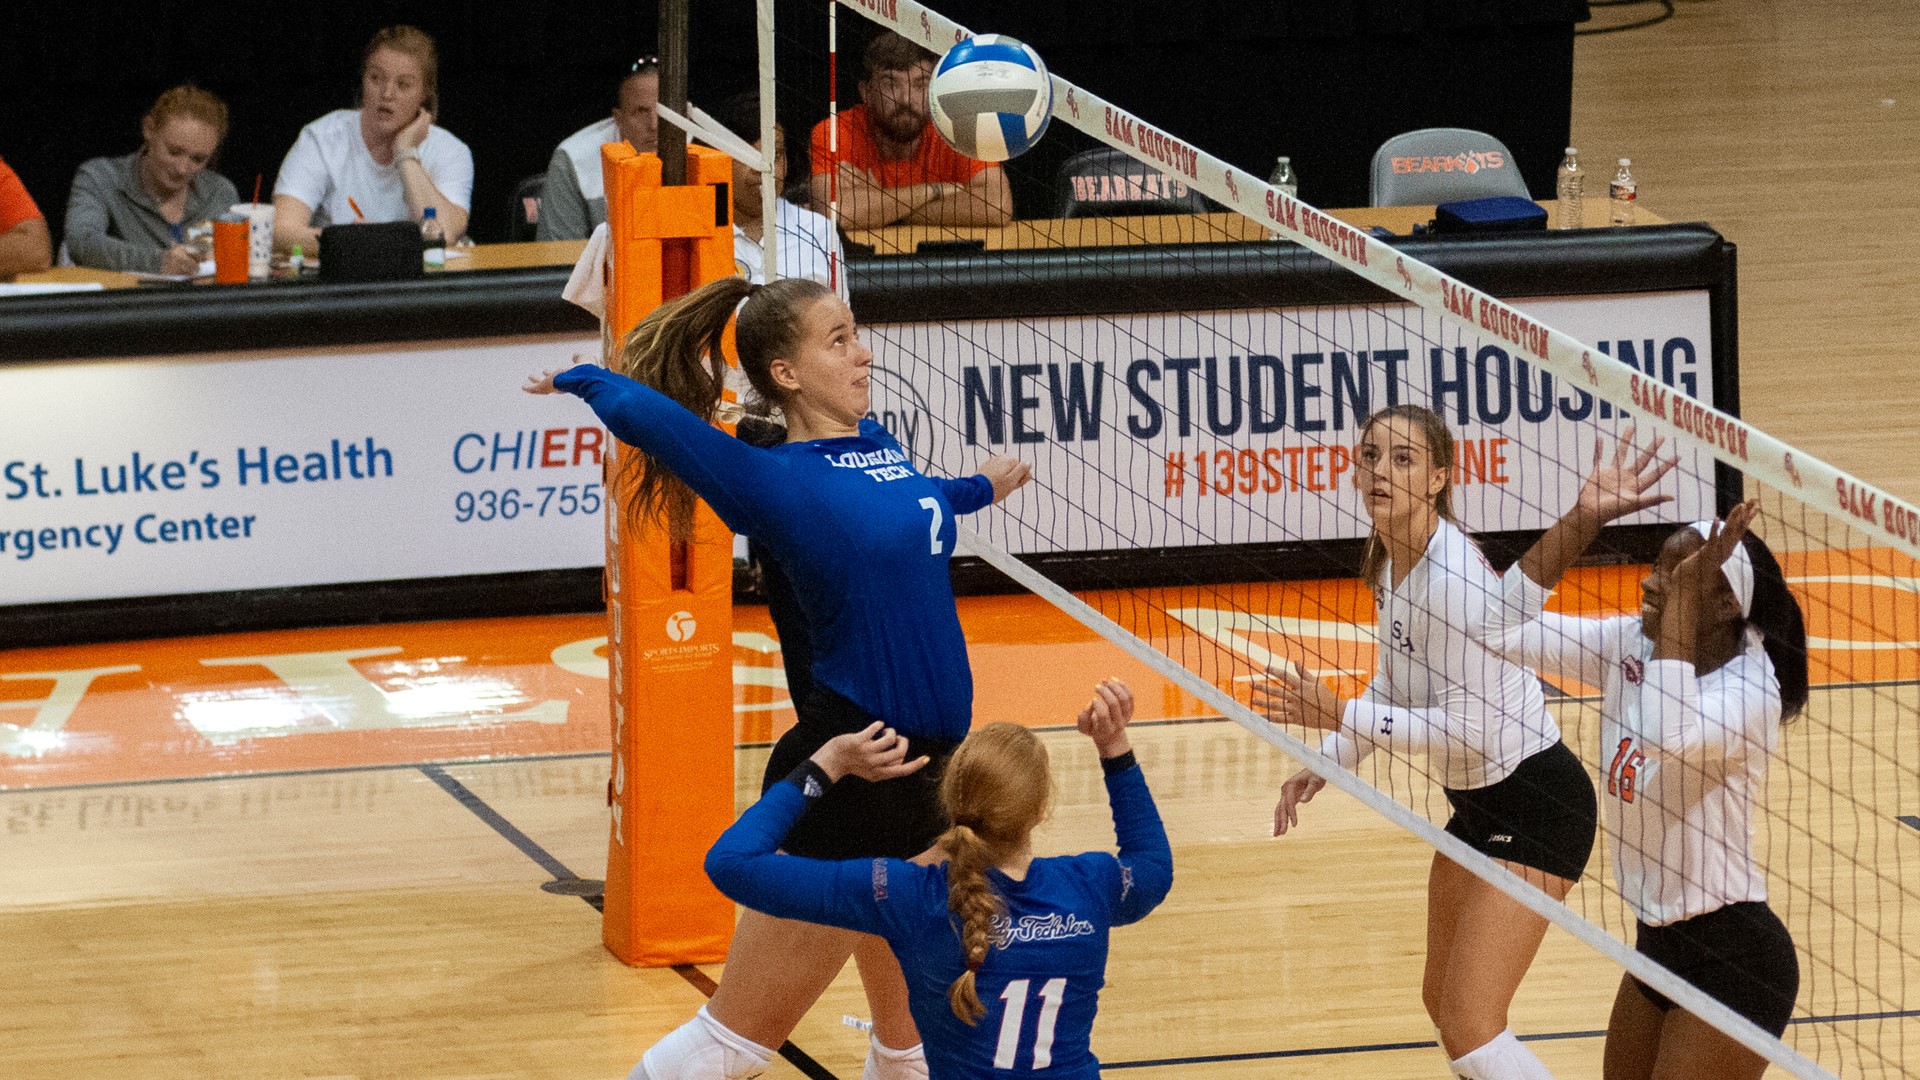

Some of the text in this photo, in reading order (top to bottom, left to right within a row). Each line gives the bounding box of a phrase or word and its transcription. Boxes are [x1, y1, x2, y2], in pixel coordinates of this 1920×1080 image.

[1105, 106, 1135, 147] SAM
[1137, 123, 1198, 180] HOUSTON
[1265, 189, 1298, 231] SAM
[1302, 207, 1368, 267] HOUSTON
[1441, 278, 1474, 322] SAM
[1479, 298, 1549, 360] HOUSTON
[1630, 374, 1666, 420] SAM
[1672, 394, 1748, 462] HOUSTON
[1836, 477, 1877, 526] SAM
[963, 361, 1105, 446] NEW
[1126, 349, 1409, 440] STUDENT
[4, 437, 395, 500] St. Luke's Health
[863, 465, 915, 482] TECH
[134, 512, 256, 544] Center
[455, 483, 600, 523] 936-755
[918, 496, 943, 555] 2
[1608, 736, 1646, 804] 16
[993, 977, 1067, 1070] 11
